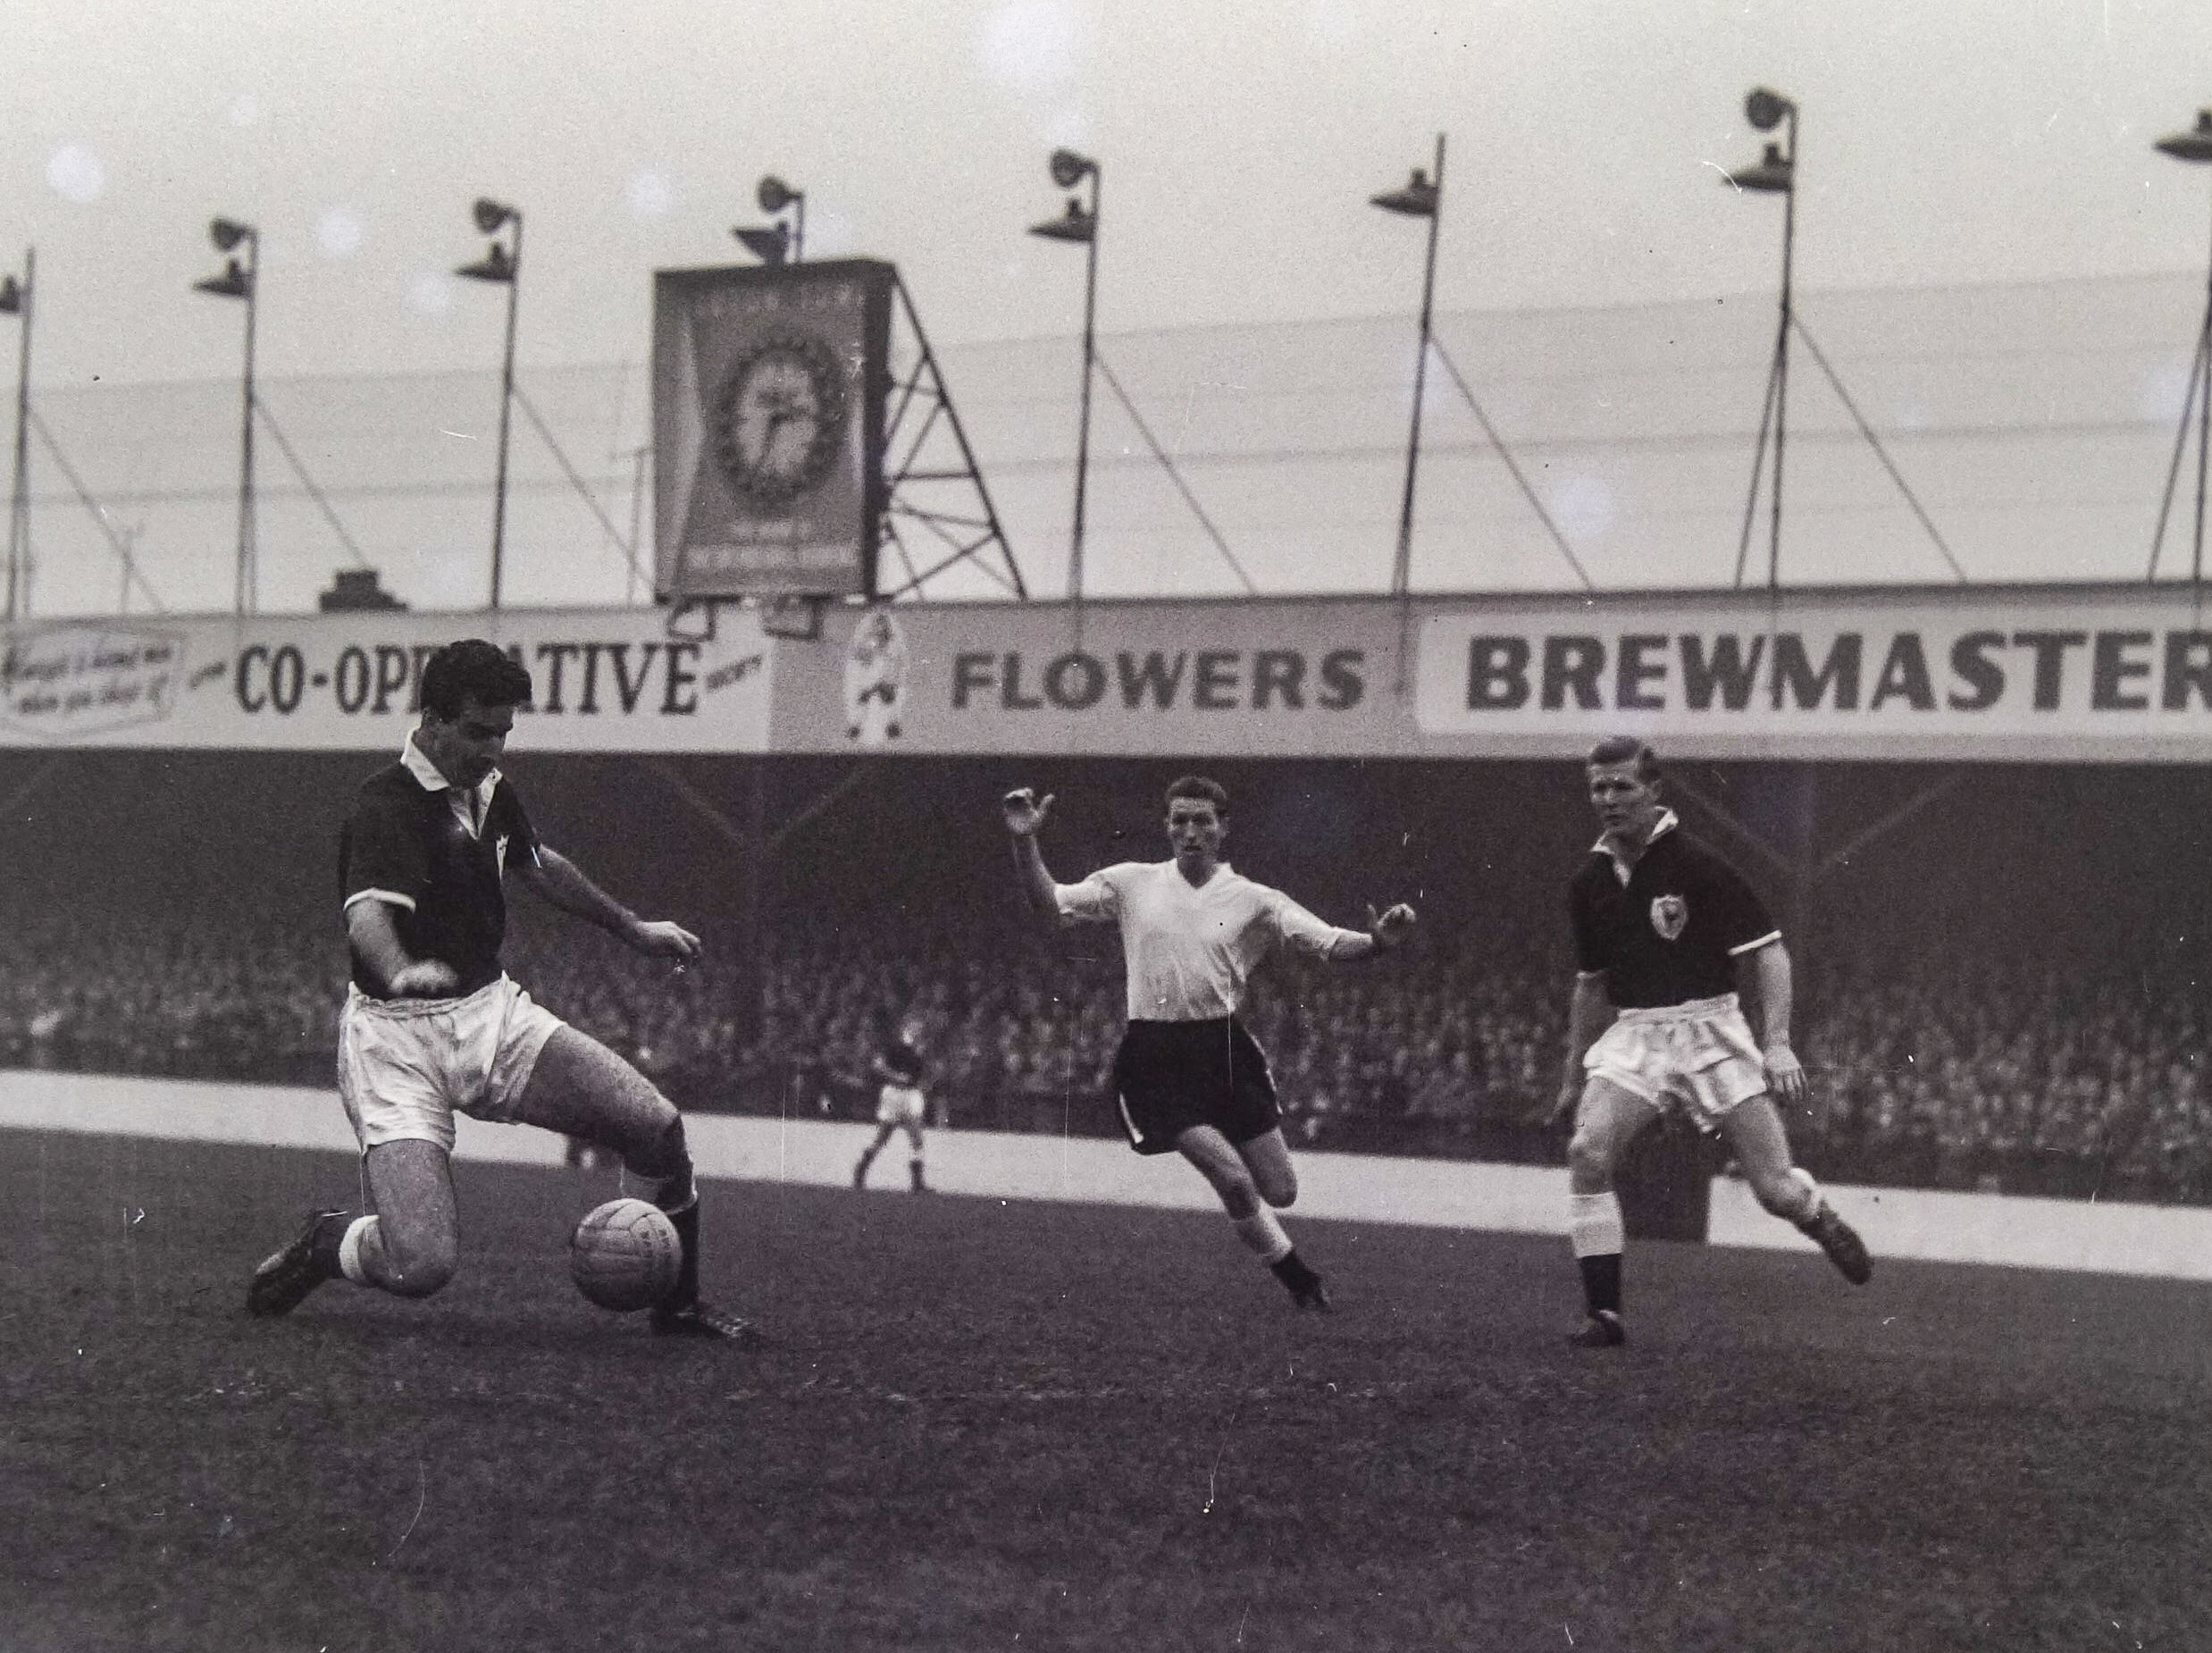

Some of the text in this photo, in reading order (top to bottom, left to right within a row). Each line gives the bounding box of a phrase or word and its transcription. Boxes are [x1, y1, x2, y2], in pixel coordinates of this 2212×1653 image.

[236, 644, 700, 715] CO-OPTIVE
[952, 650, 1365, 710] FLOWERS
[1467, 632, 2212, 711] BREWMASTER
